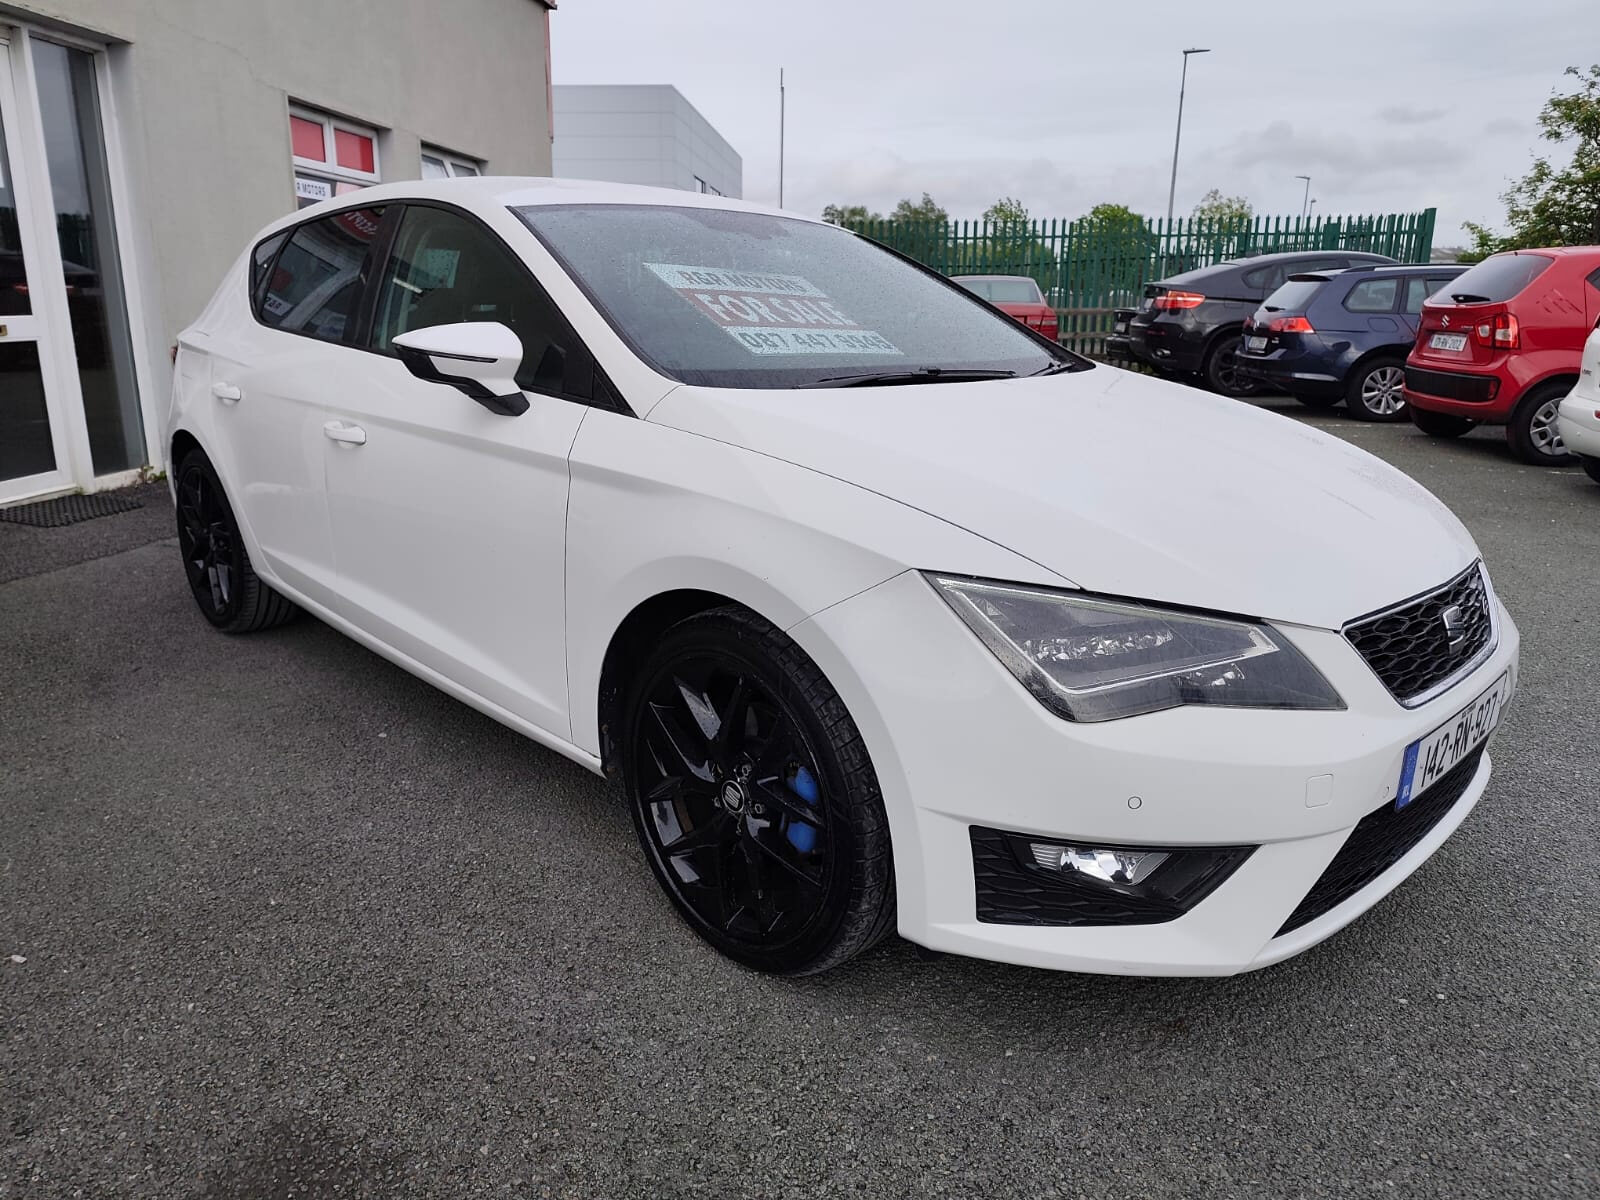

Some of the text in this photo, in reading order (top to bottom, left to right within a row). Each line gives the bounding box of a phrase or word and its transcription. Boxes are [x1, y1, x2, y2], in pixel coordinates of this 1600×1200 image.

[302, 182, 327, 197] MOTORS
[722, 273, 808, 293] MOTORS
[694, 293, 859, 326] FOR SALE
[738, 332, 790, 348] 087
[791, 333, 837, 348] 447
[1420, 688, 1499, 788] 142-RN-927
